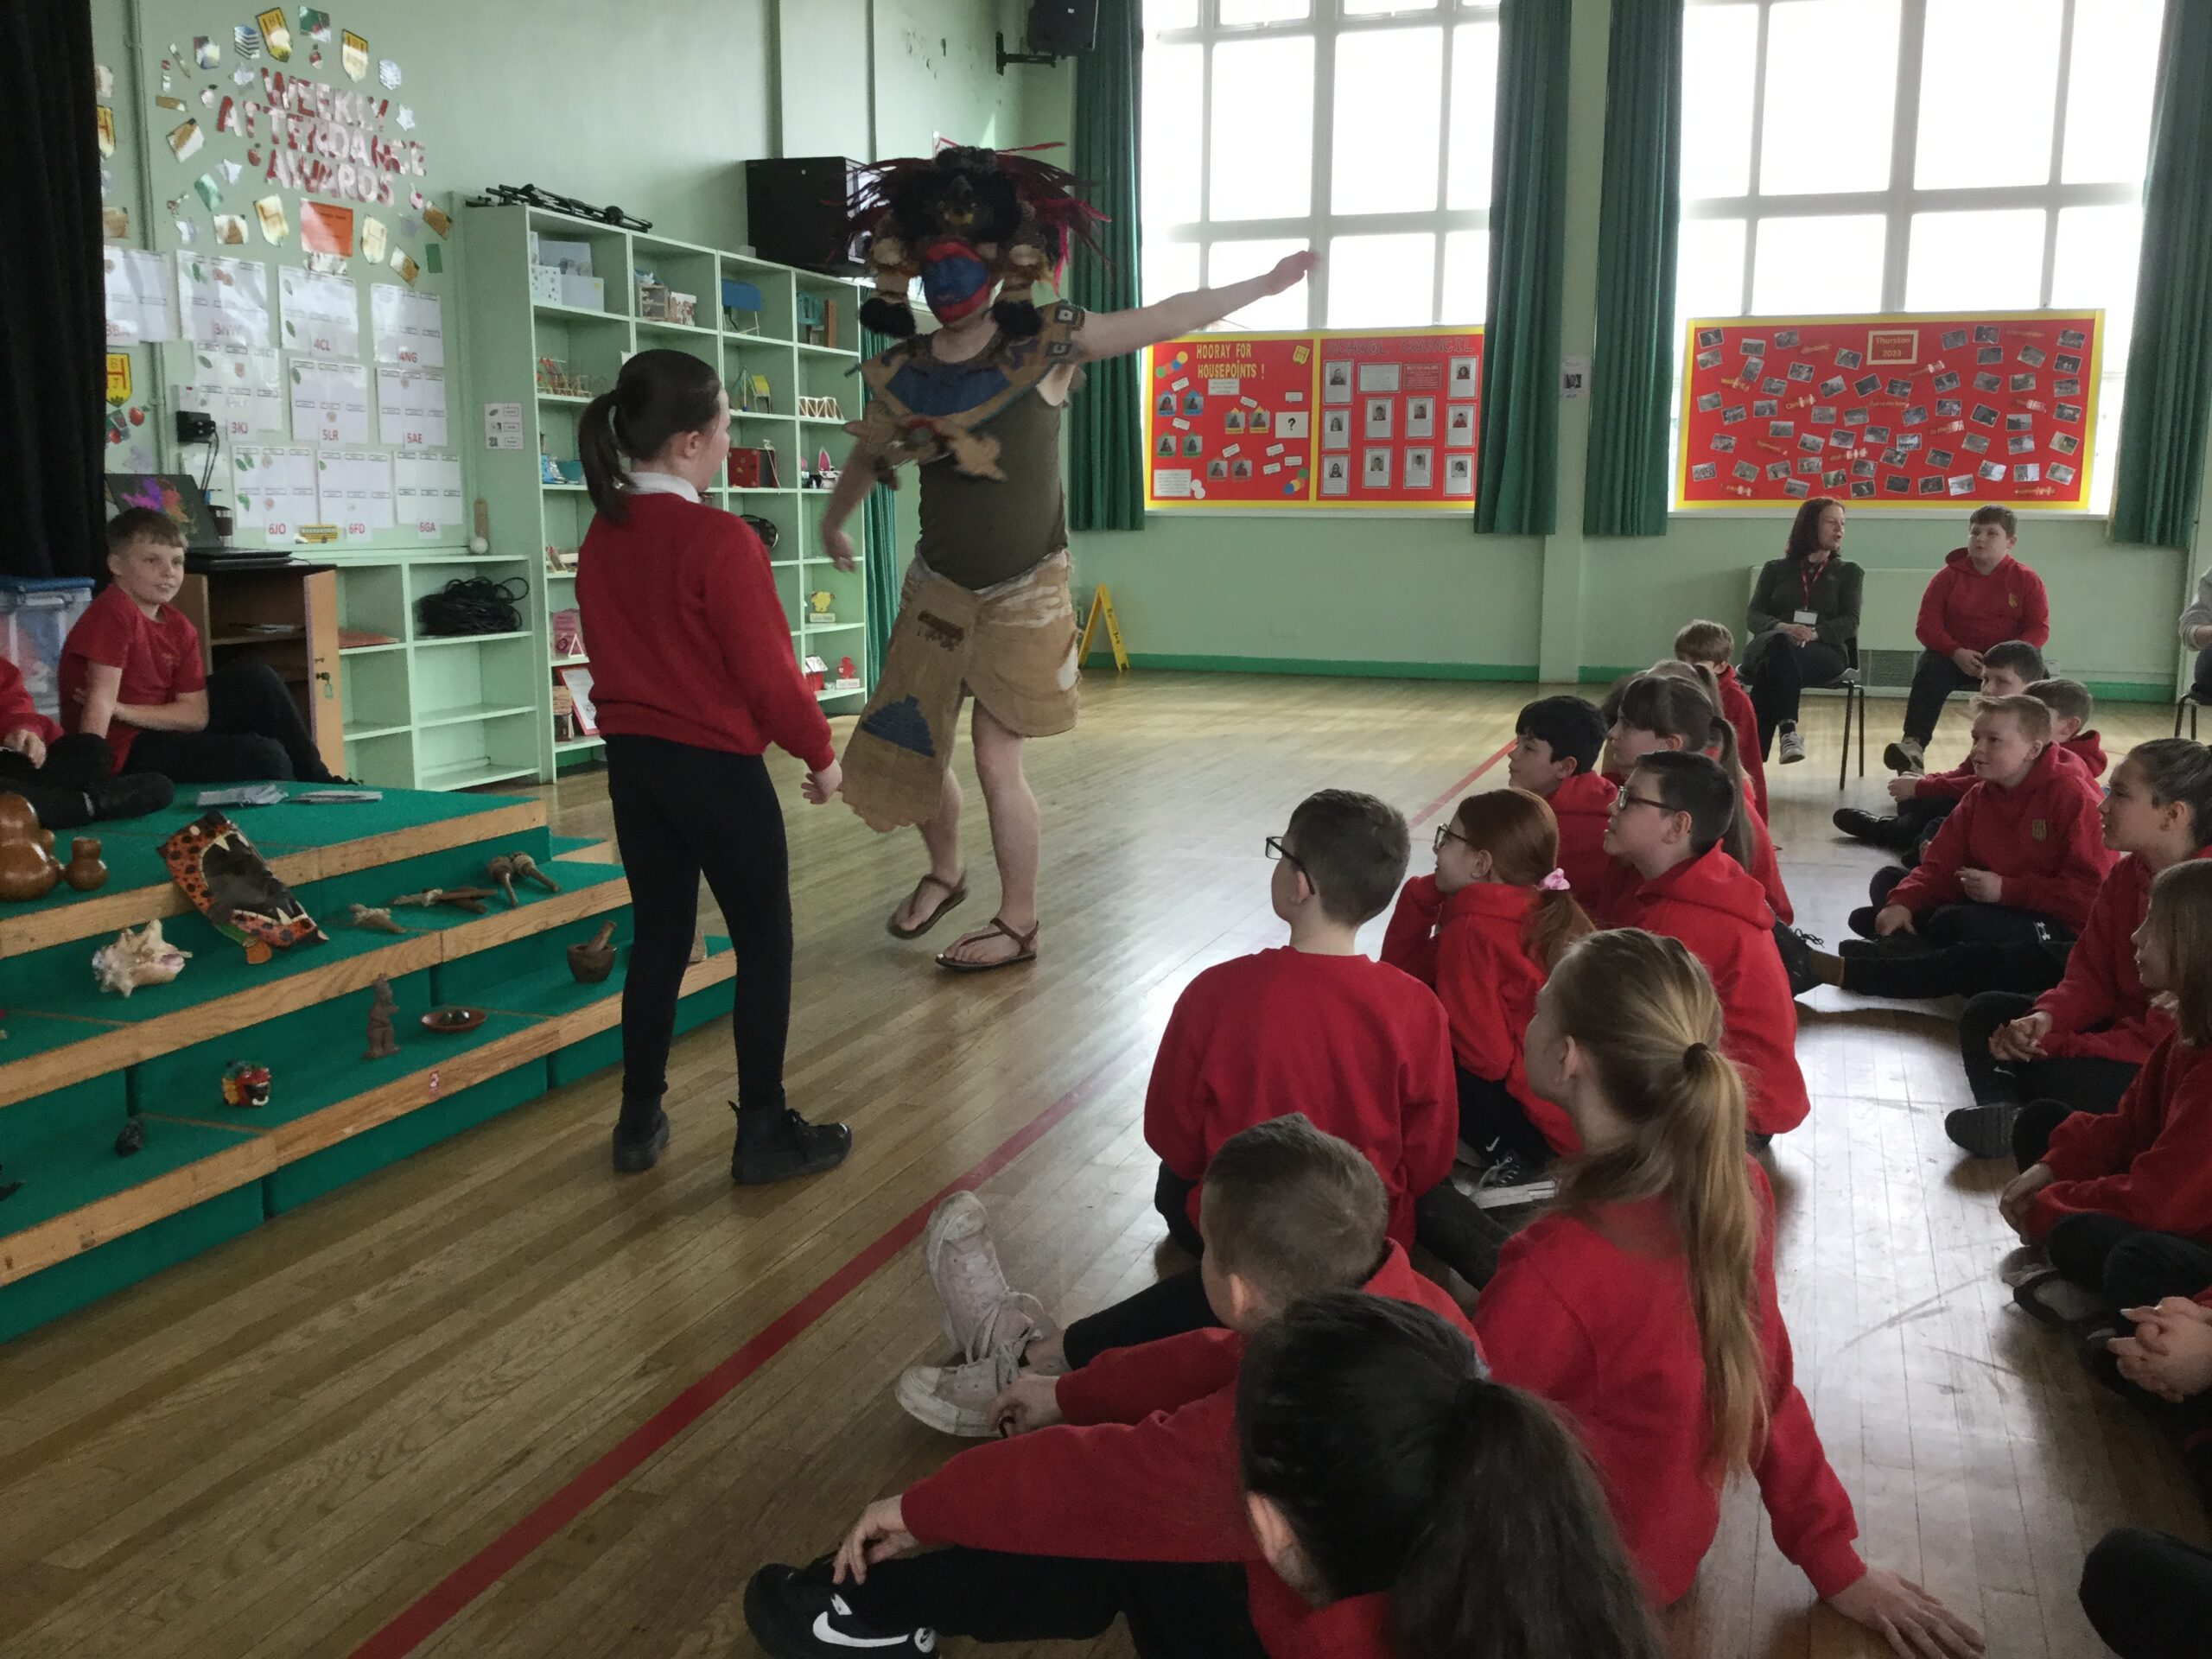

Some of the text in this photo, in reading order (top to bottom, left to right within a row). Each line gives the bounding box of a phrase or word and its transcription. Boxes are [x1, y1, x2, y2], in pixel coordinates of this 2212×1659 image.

[261, 67, 388, 131] WEEKLY
[217, 96, 426, 175] ATTENDANCE
[265, 149, 394, 207] AWARDS
[314, 339, 331, 351] 4CL
[1197, 343, 1251, 359] HOORAY FOR
[1326, 338, 1476, 355] SCHOOL COUNCIL
[399, 351, 417, 363] 4NG
[1287, 417, 1296, 431] ?
[322, 429, 339, 441] 5LR
[407, 433, 423, 443] 5AE
[269, 524, 287, 535] 6JO
[349, 523, 365, 534] 6FD
